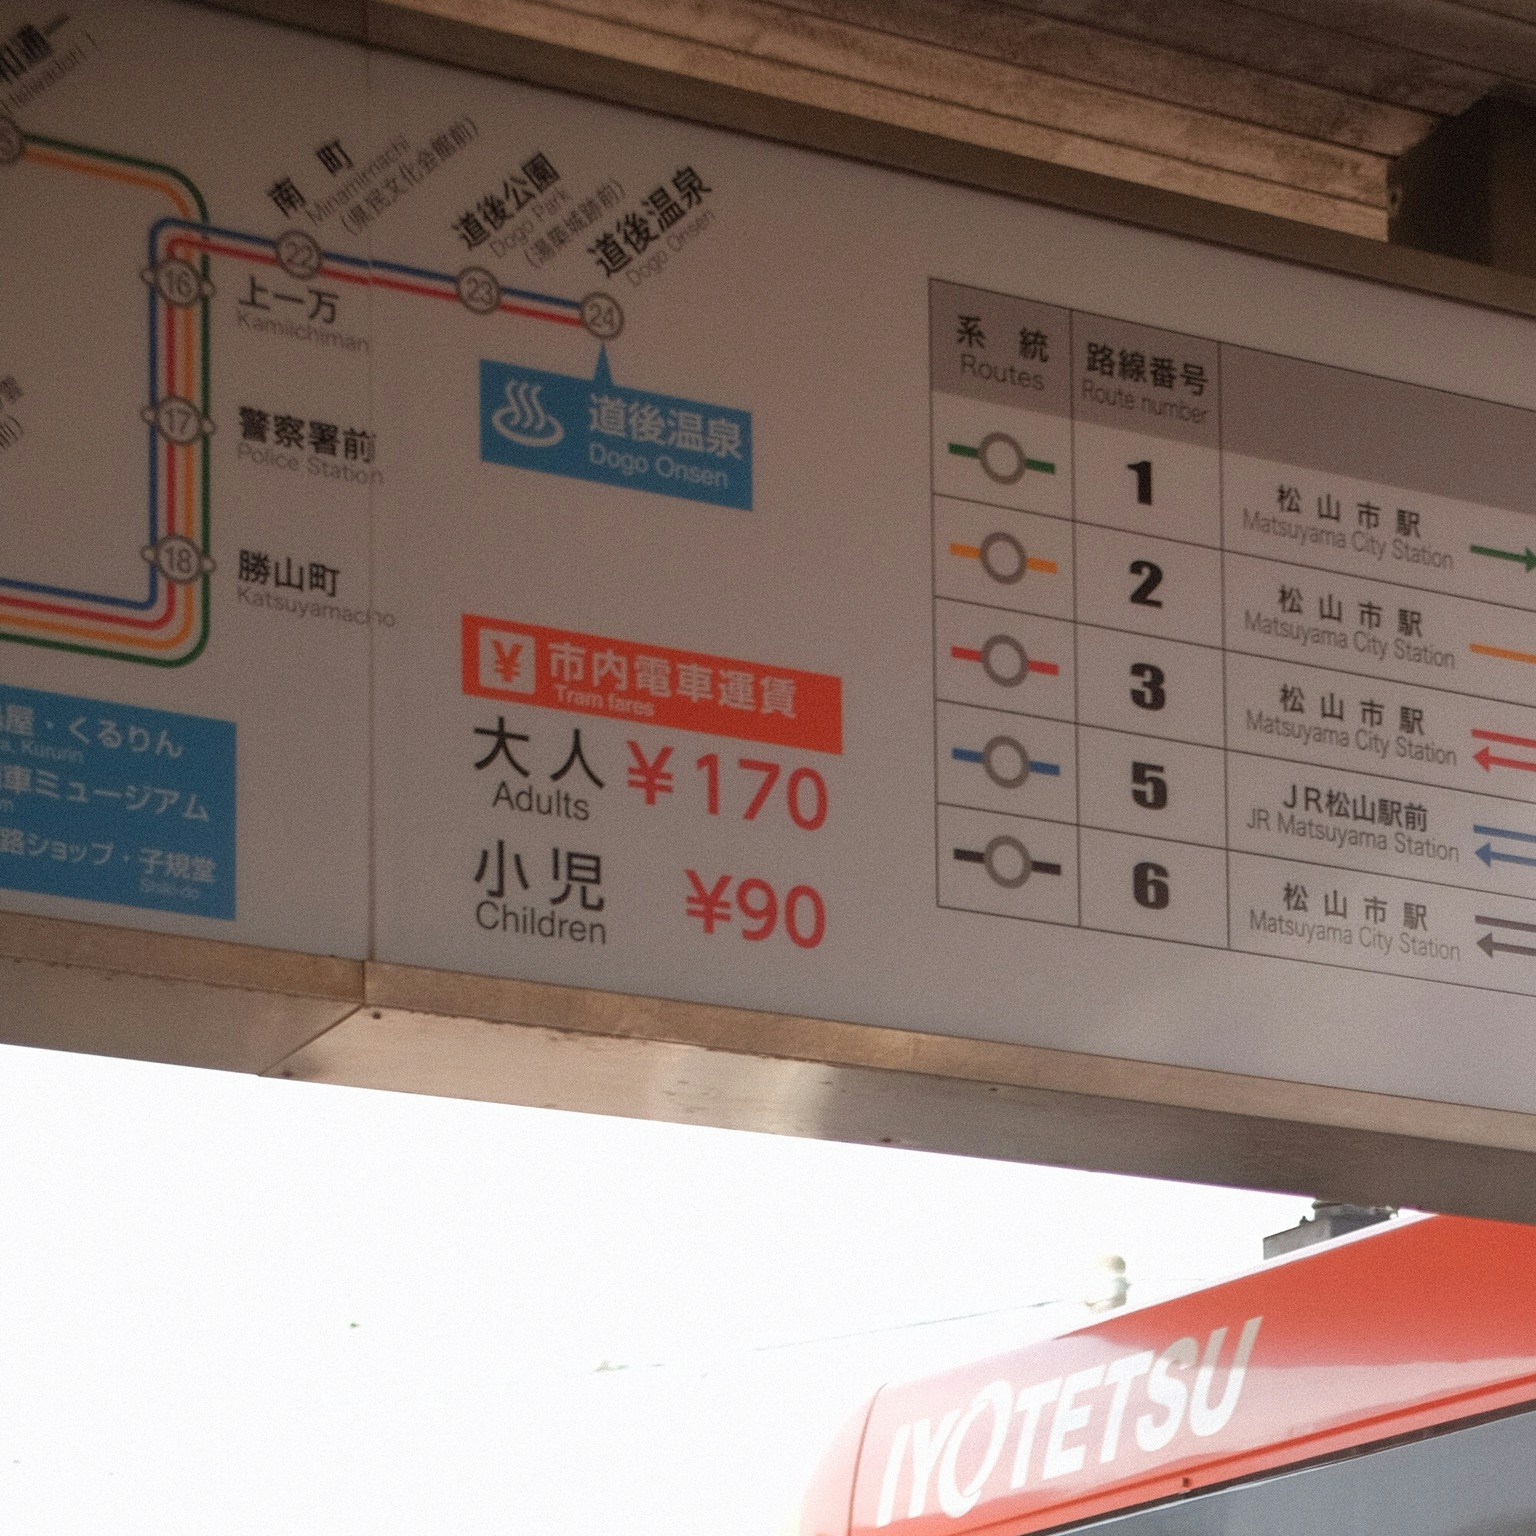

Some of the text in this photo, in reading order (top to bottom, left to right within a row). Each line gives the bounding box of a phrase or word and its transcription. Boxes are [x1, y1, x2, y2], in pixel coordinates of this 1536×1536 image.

[586, 164, 714, 279] 道後温泉
[238, 275, 341, 325] 上一万
[959, 352, 1046, 393] Routes
[1086, 340, 1209, 398] 路線番号
[165, 406, 193, 436] 17
[1081, 377, 1209, 425] Route number
[238, 405, 377, 464] 警察署前
[588, 394, 746, 465] 道後温泉
[236, 442, 385, 486] Police Station
[589, 442, 730, 491] Dogo Onsen
[1126, 459, 1154, 506] 1
[165, 547, 193, 574] 18
[1242, 507, 1455, 571] Matsuyama City Station
[238, 548, 342, 599] 勝山町
[1129, 559, 1165, 610] 2
[1244, 609, 1457, 672] Matsuyama City Station
[548, 641, 798, 719] 市内電車運賃
[554, 683, 655, 718] Tram fares
[1129, 662, 1167, 713] 3
[473, 715, 605, 790] 大人
[1245, 708, 1458, 768] Matsuyama City Station
[491, 780, 591, 822] Adults
[626, 739, 829, 832] ¥170
[1131, 761, 1169, 811] 5
[1245, 808, 1460, 864] JR Matsuyama Station
[473, 839, 605, 913] 小児
[1131, 861, 1171, 911] 6
[474, 900, 607, 946] Children
[684, 868, 828, 950] ¥90
[1248, 908, 1462, 963] Matsuyama City Station
[876, 1315, 1264, 1528] IYOTETSU
